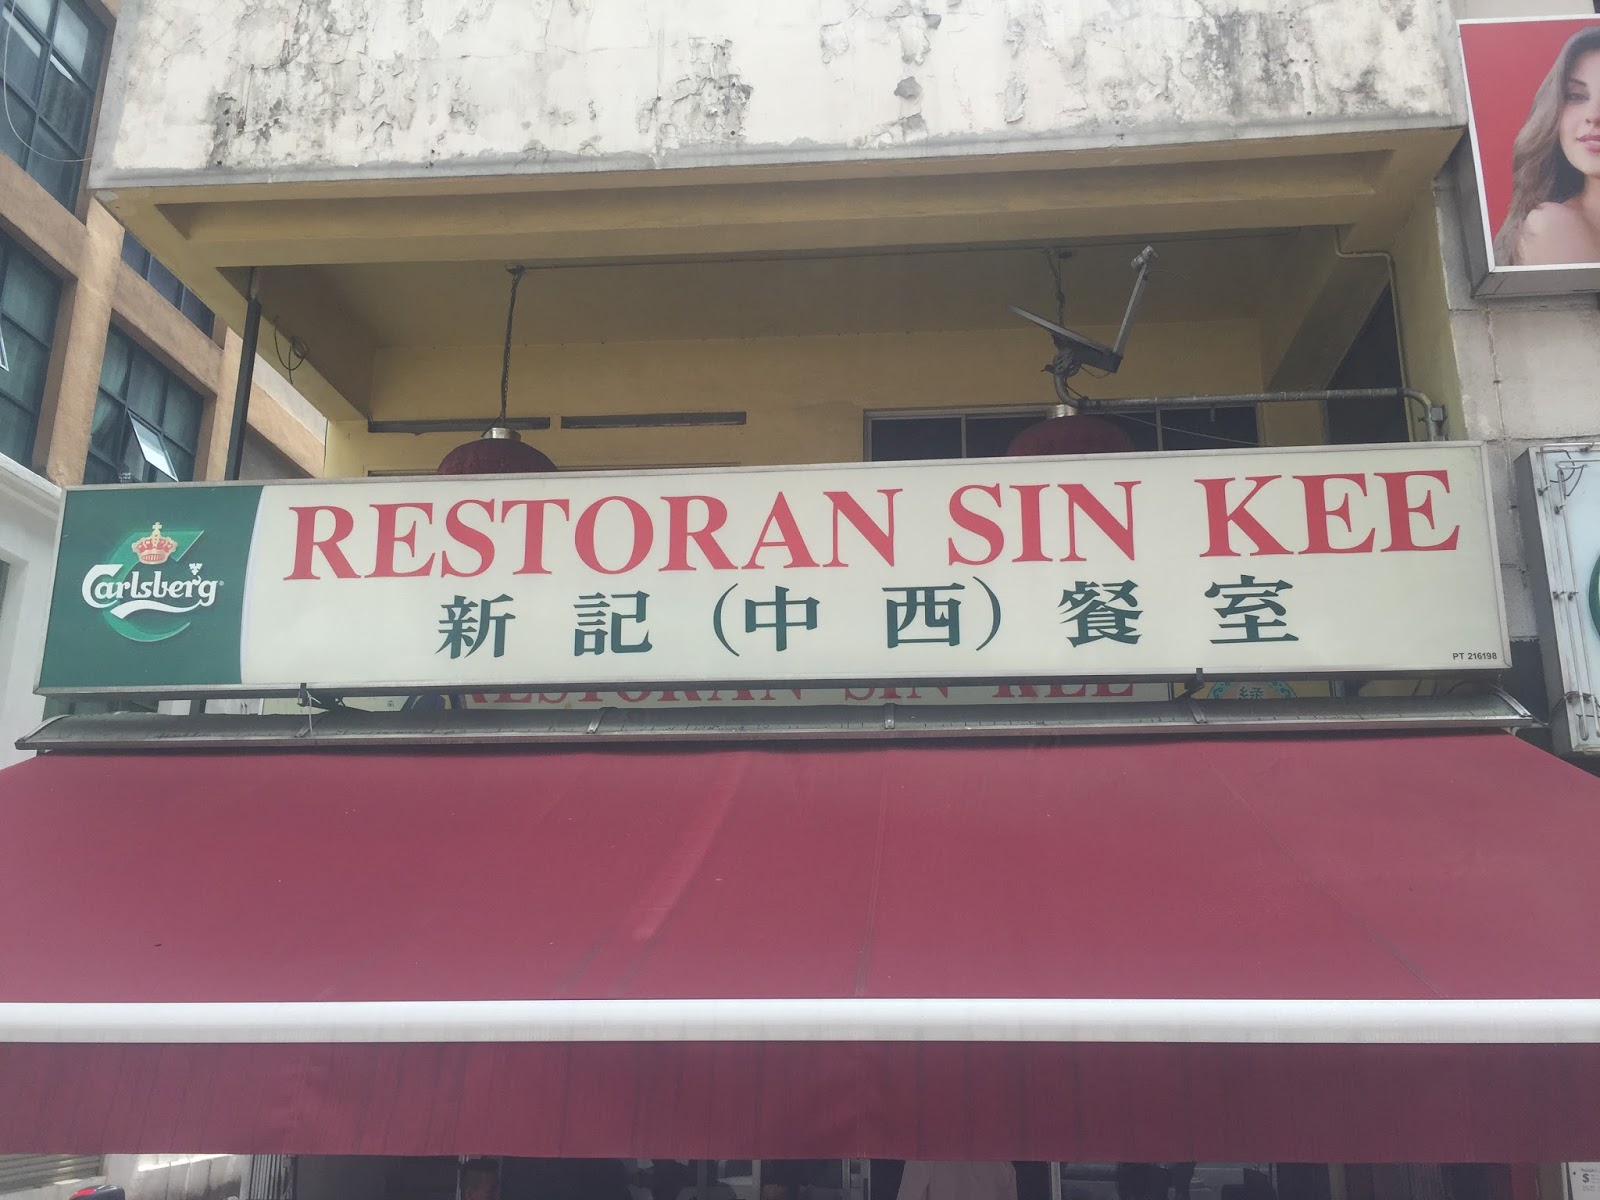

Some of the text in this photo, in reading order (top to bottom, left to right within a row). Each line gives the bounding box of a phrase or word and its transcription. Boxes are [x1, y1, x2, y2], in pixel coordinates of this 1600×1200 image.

[284, 469, 1459, 580] RESTORAN SIN KEE
[82, 564, 218, 607] Carlsberg
[1452, 652, 1498, 660] PT 216198
